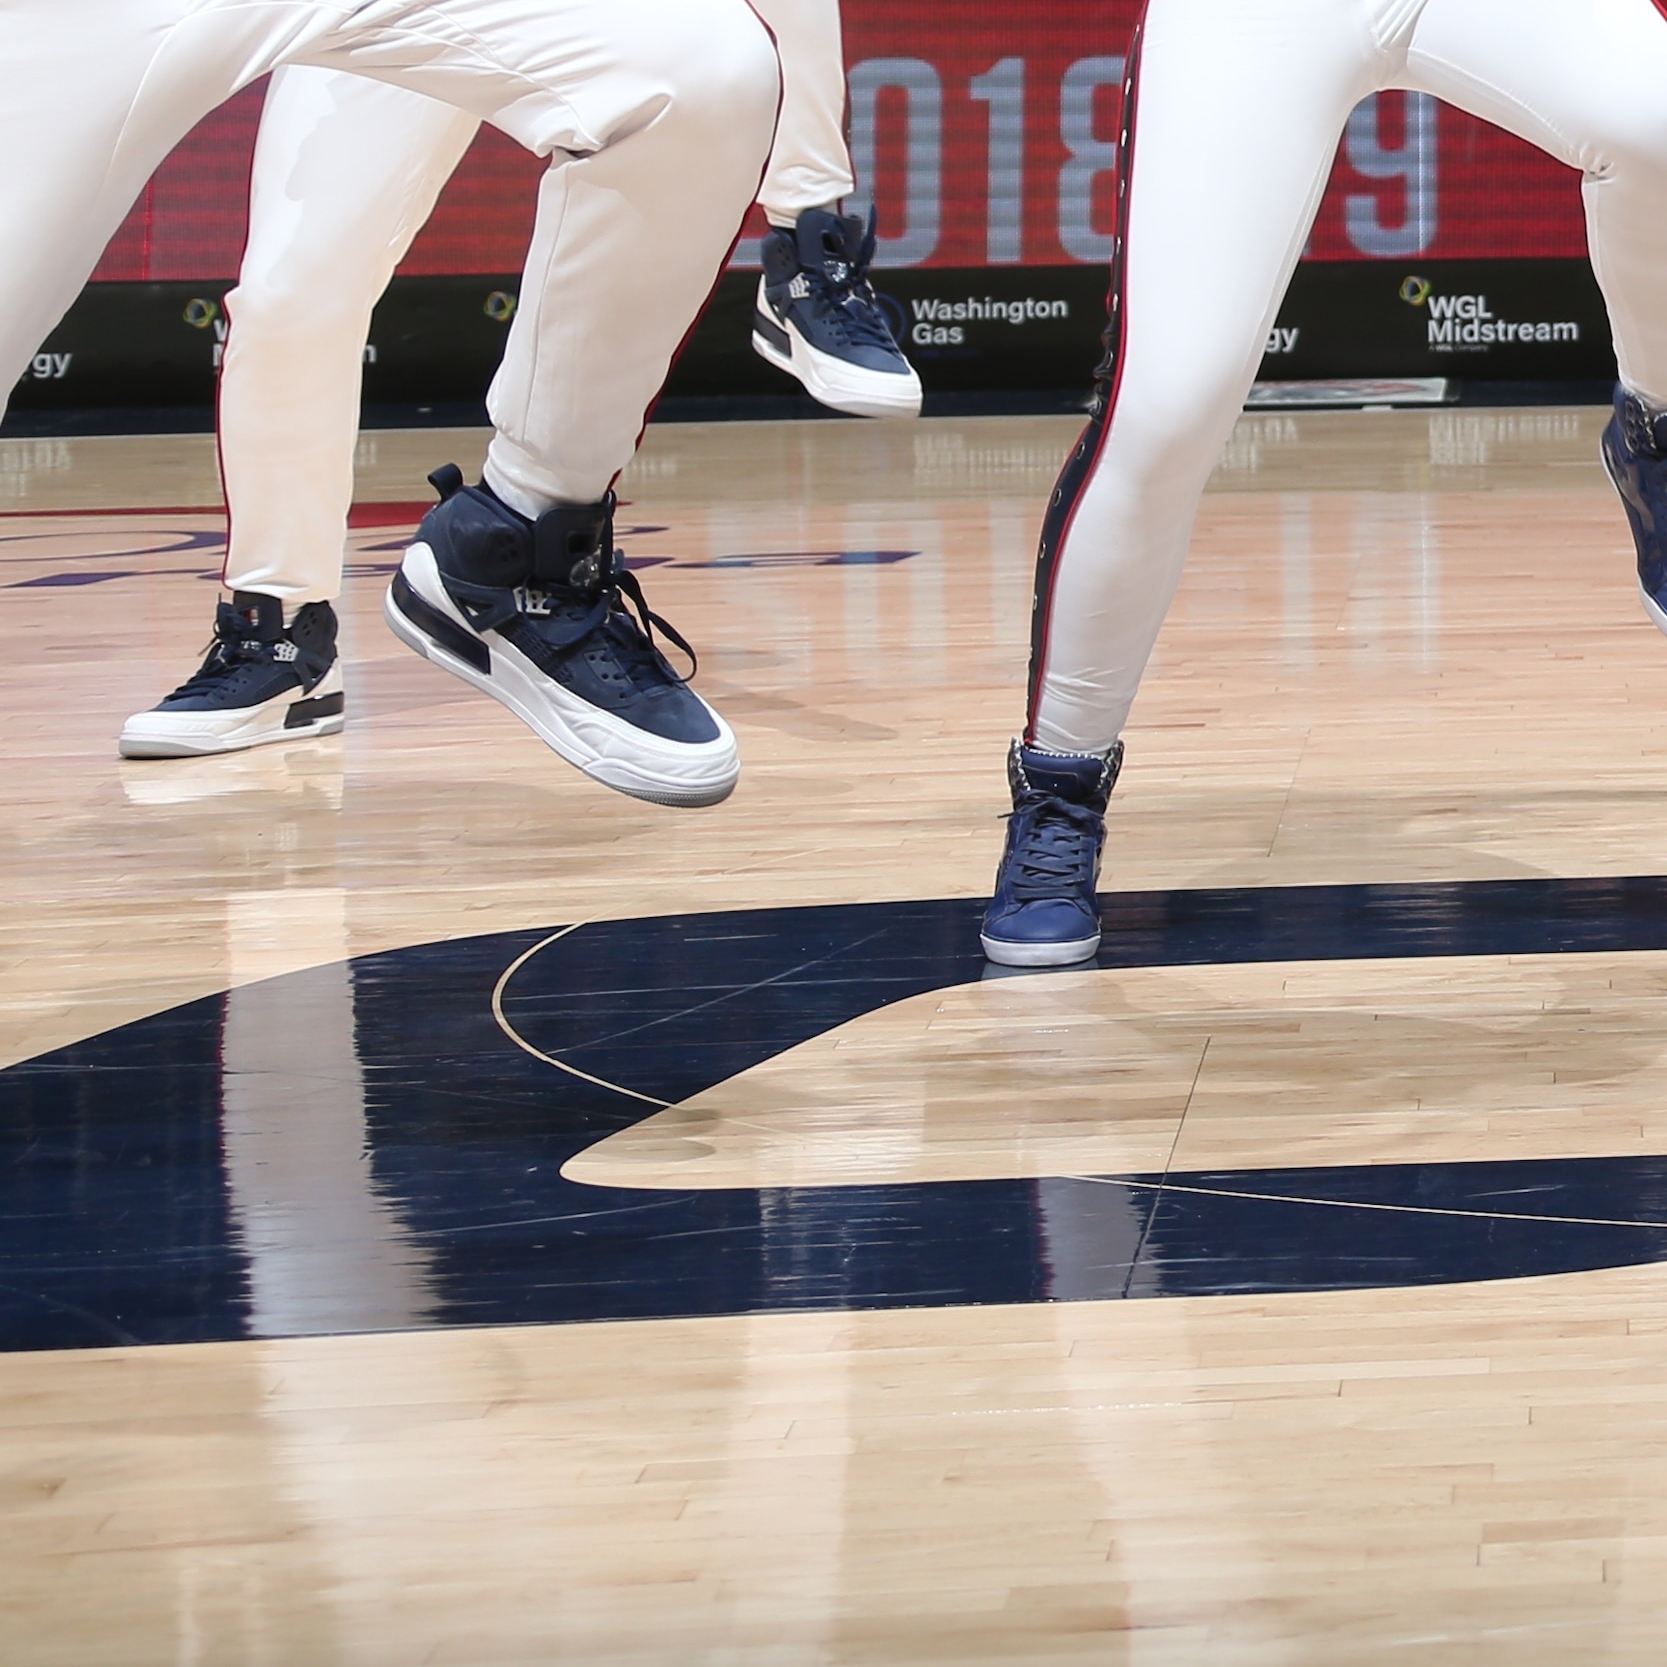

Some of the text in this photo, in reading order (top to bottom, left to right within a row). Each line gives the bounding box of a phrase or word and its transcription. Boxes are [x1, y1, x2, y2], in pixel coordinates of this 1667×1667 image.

[911, 297, 1069, 325] Washington
[1428, 295, 1492, 319] WGL
[912, 323, 964, 345] Gas
[1427, 318, 1578, 343] Midstream
